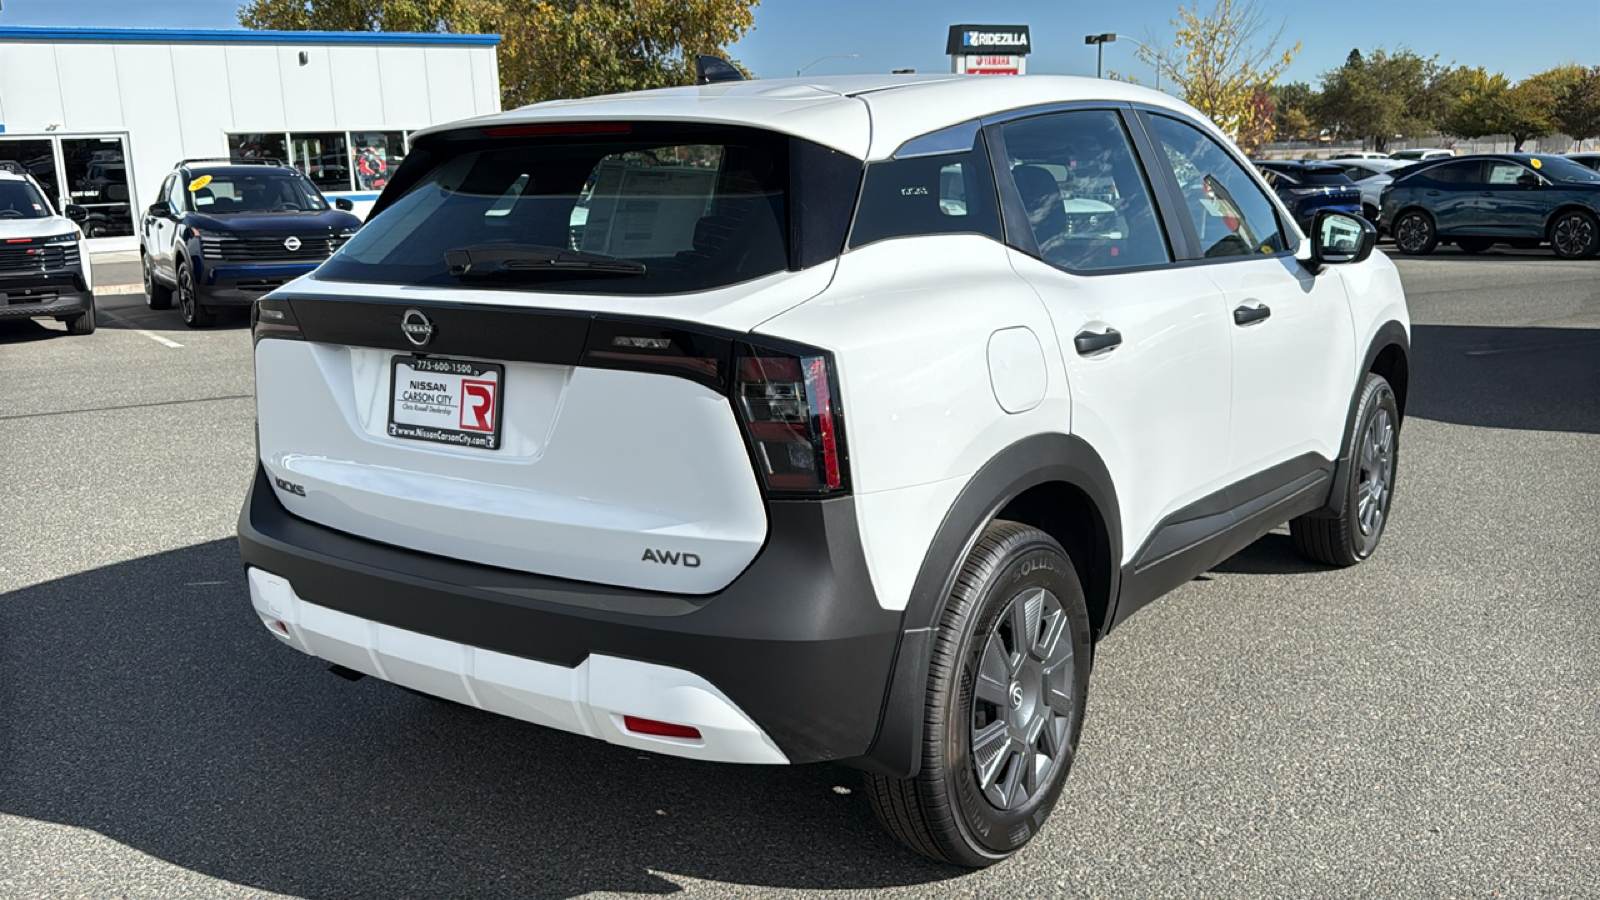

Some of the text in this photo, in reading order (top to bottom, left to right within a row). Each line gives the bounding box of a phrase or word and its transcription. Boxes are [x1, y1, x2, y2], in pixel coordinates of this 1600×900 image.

[979, 33, 1028, 46] RIDEZILLA
[984, 55, 1010, 66] YAMAHA
[417, 361, 472, 373] 775-600-1500
[410, 380, 447, 392] NISSAN
[403, 391, 453, 405] CARSON CITY
[398, 427, 485, 446] www.NissanCarsonCity.com
[641, 548, 701, 568] AWD
[1013, 557, 1055, 584] SOLUS
